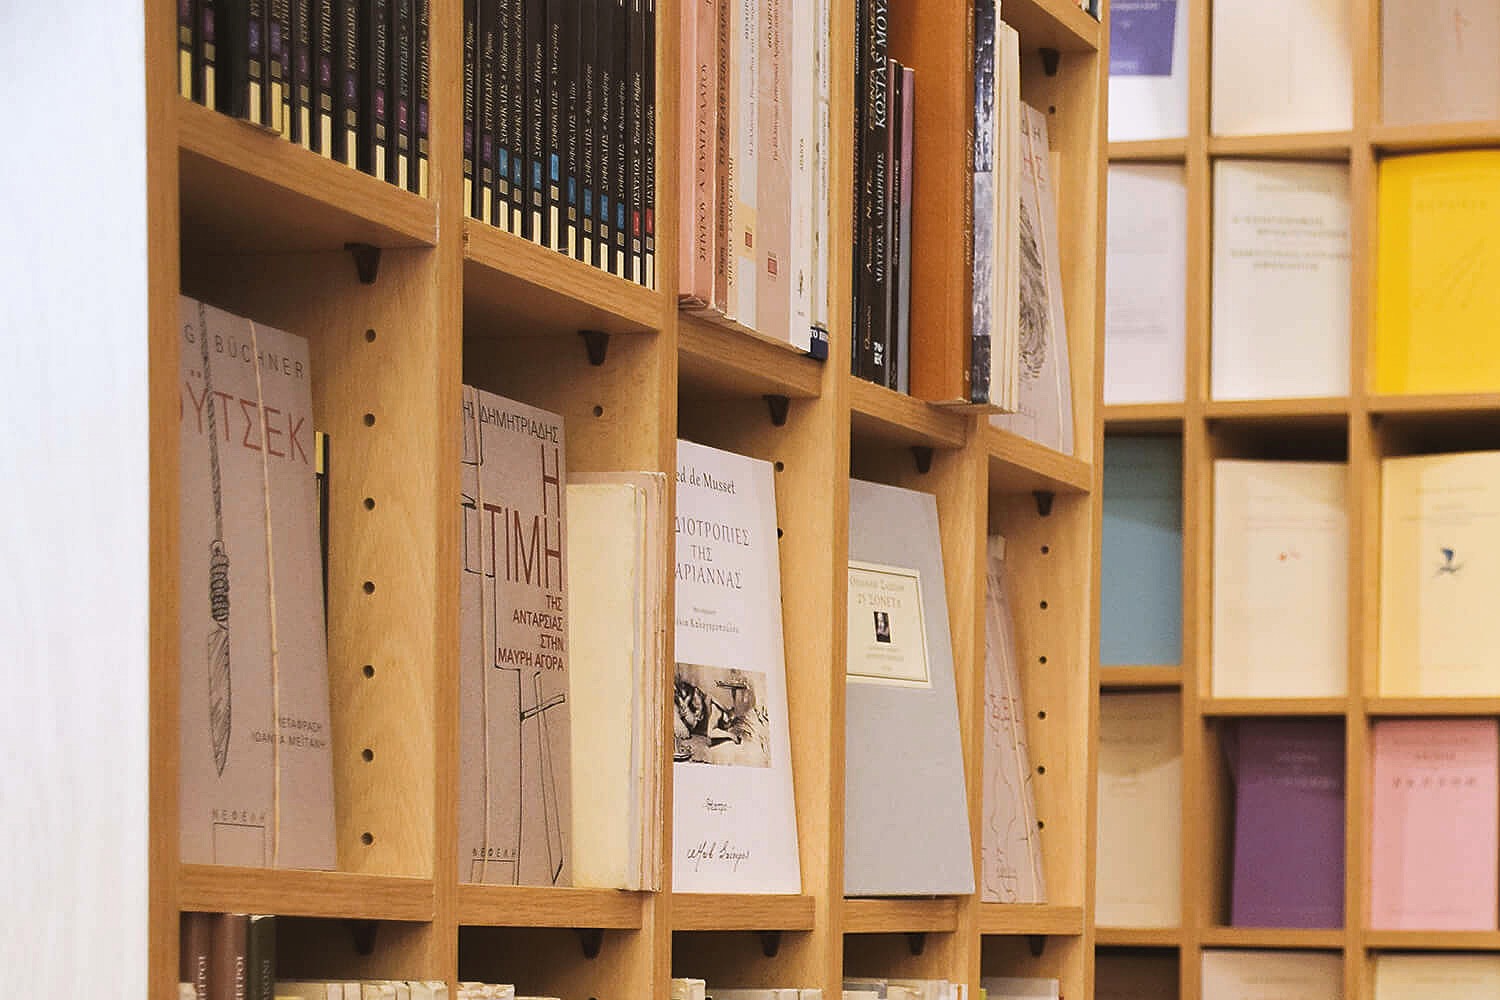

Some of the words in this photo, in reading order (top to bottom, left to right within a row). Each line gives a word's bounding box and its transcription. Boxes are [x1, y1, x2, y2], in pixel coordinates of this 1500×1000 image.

[875, 54, 888, 129] ΚΩΣΤΑΣ
[215, 331, 306, 378] BÜCHNER
[479, 404, 560, 444] ΔΗΜΗΤΡΙΑΔΗΣ
[541, 444, 563, 518] Η
[689, 471, 701, 489] de
[703, 471, 737, 497] Musset
[675, 516, 751, 547] ΔΙΟΤΡΟΠΙΕΣ
[483, 503, 563, 593] ΤΙΜΗ
[690, 543, 714, 562] ΤΗΣ
[675, 562, 743, 590] ΑΡΙΑΝΝΑΣ
[545, 594, 564, 613] ΤΗΣ
[511, 609, 564, 633] ΑΝΤΑΡΣΙΑΣ
[540, 633, 565, 651] ΣΤΗΝ
[498, 647, 533, 668] ΜΑΥΡΗ
[534, 651, 565, 672] ΑΓΟΡΑ
